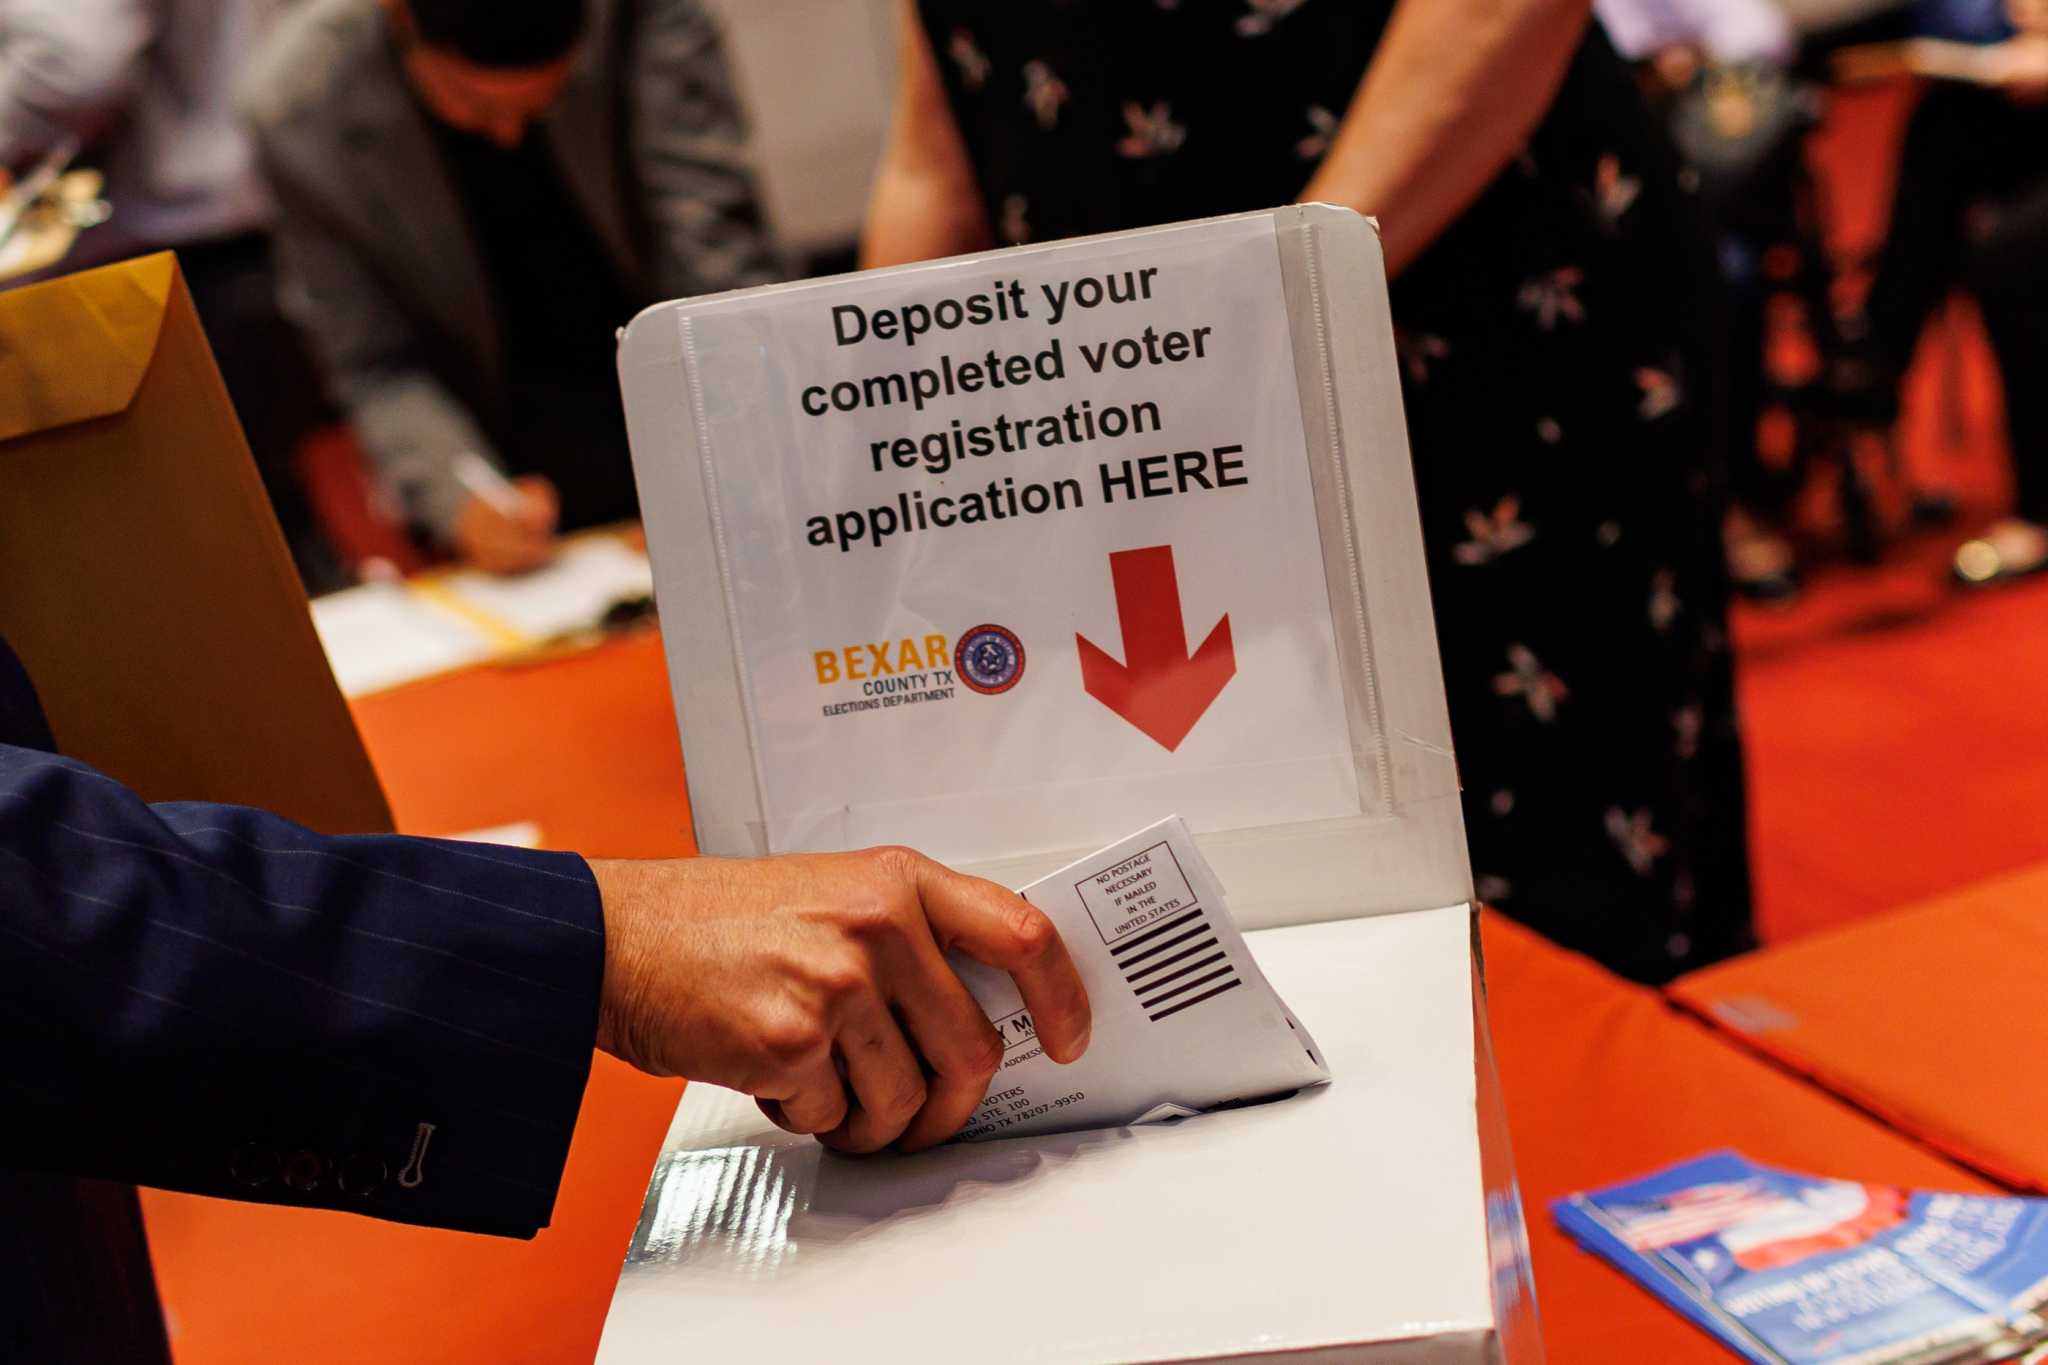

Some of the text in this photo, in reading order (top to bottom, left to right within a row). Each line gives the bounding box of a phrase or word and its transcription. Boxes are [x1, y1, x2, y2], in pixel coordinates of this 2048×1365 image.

[831, 267, 1158, 346] Deposit your
[801, 326, 1212, 416] completed voter
[870, 399, 1161, 474] registration
[806, 445, 1249, 552] application HERE
[814, 634, 951, 685] BEXAR
[863, 670, 954, 696] COUNTY TX
[823, 688, 955, 716] ELECTIONS DEPARTMENT
[1096, 854, 1151, 885] NO POSTAGE
[1105, 867, 1153, 895] NECESSARY
[1114, 881, 1157, 906] IF MAILED
[1127, 896, 1157, 914] IN THE
[1114, 898, 1181, 934] UNITED STATES
[982, 1086, 1025, 1107] VOTERS
[997, 1118, 1013, 1128] TX
[1015, 1091, 1085, 1122] 78207-9950
[1008, 1098, 1030, 1112] 100
